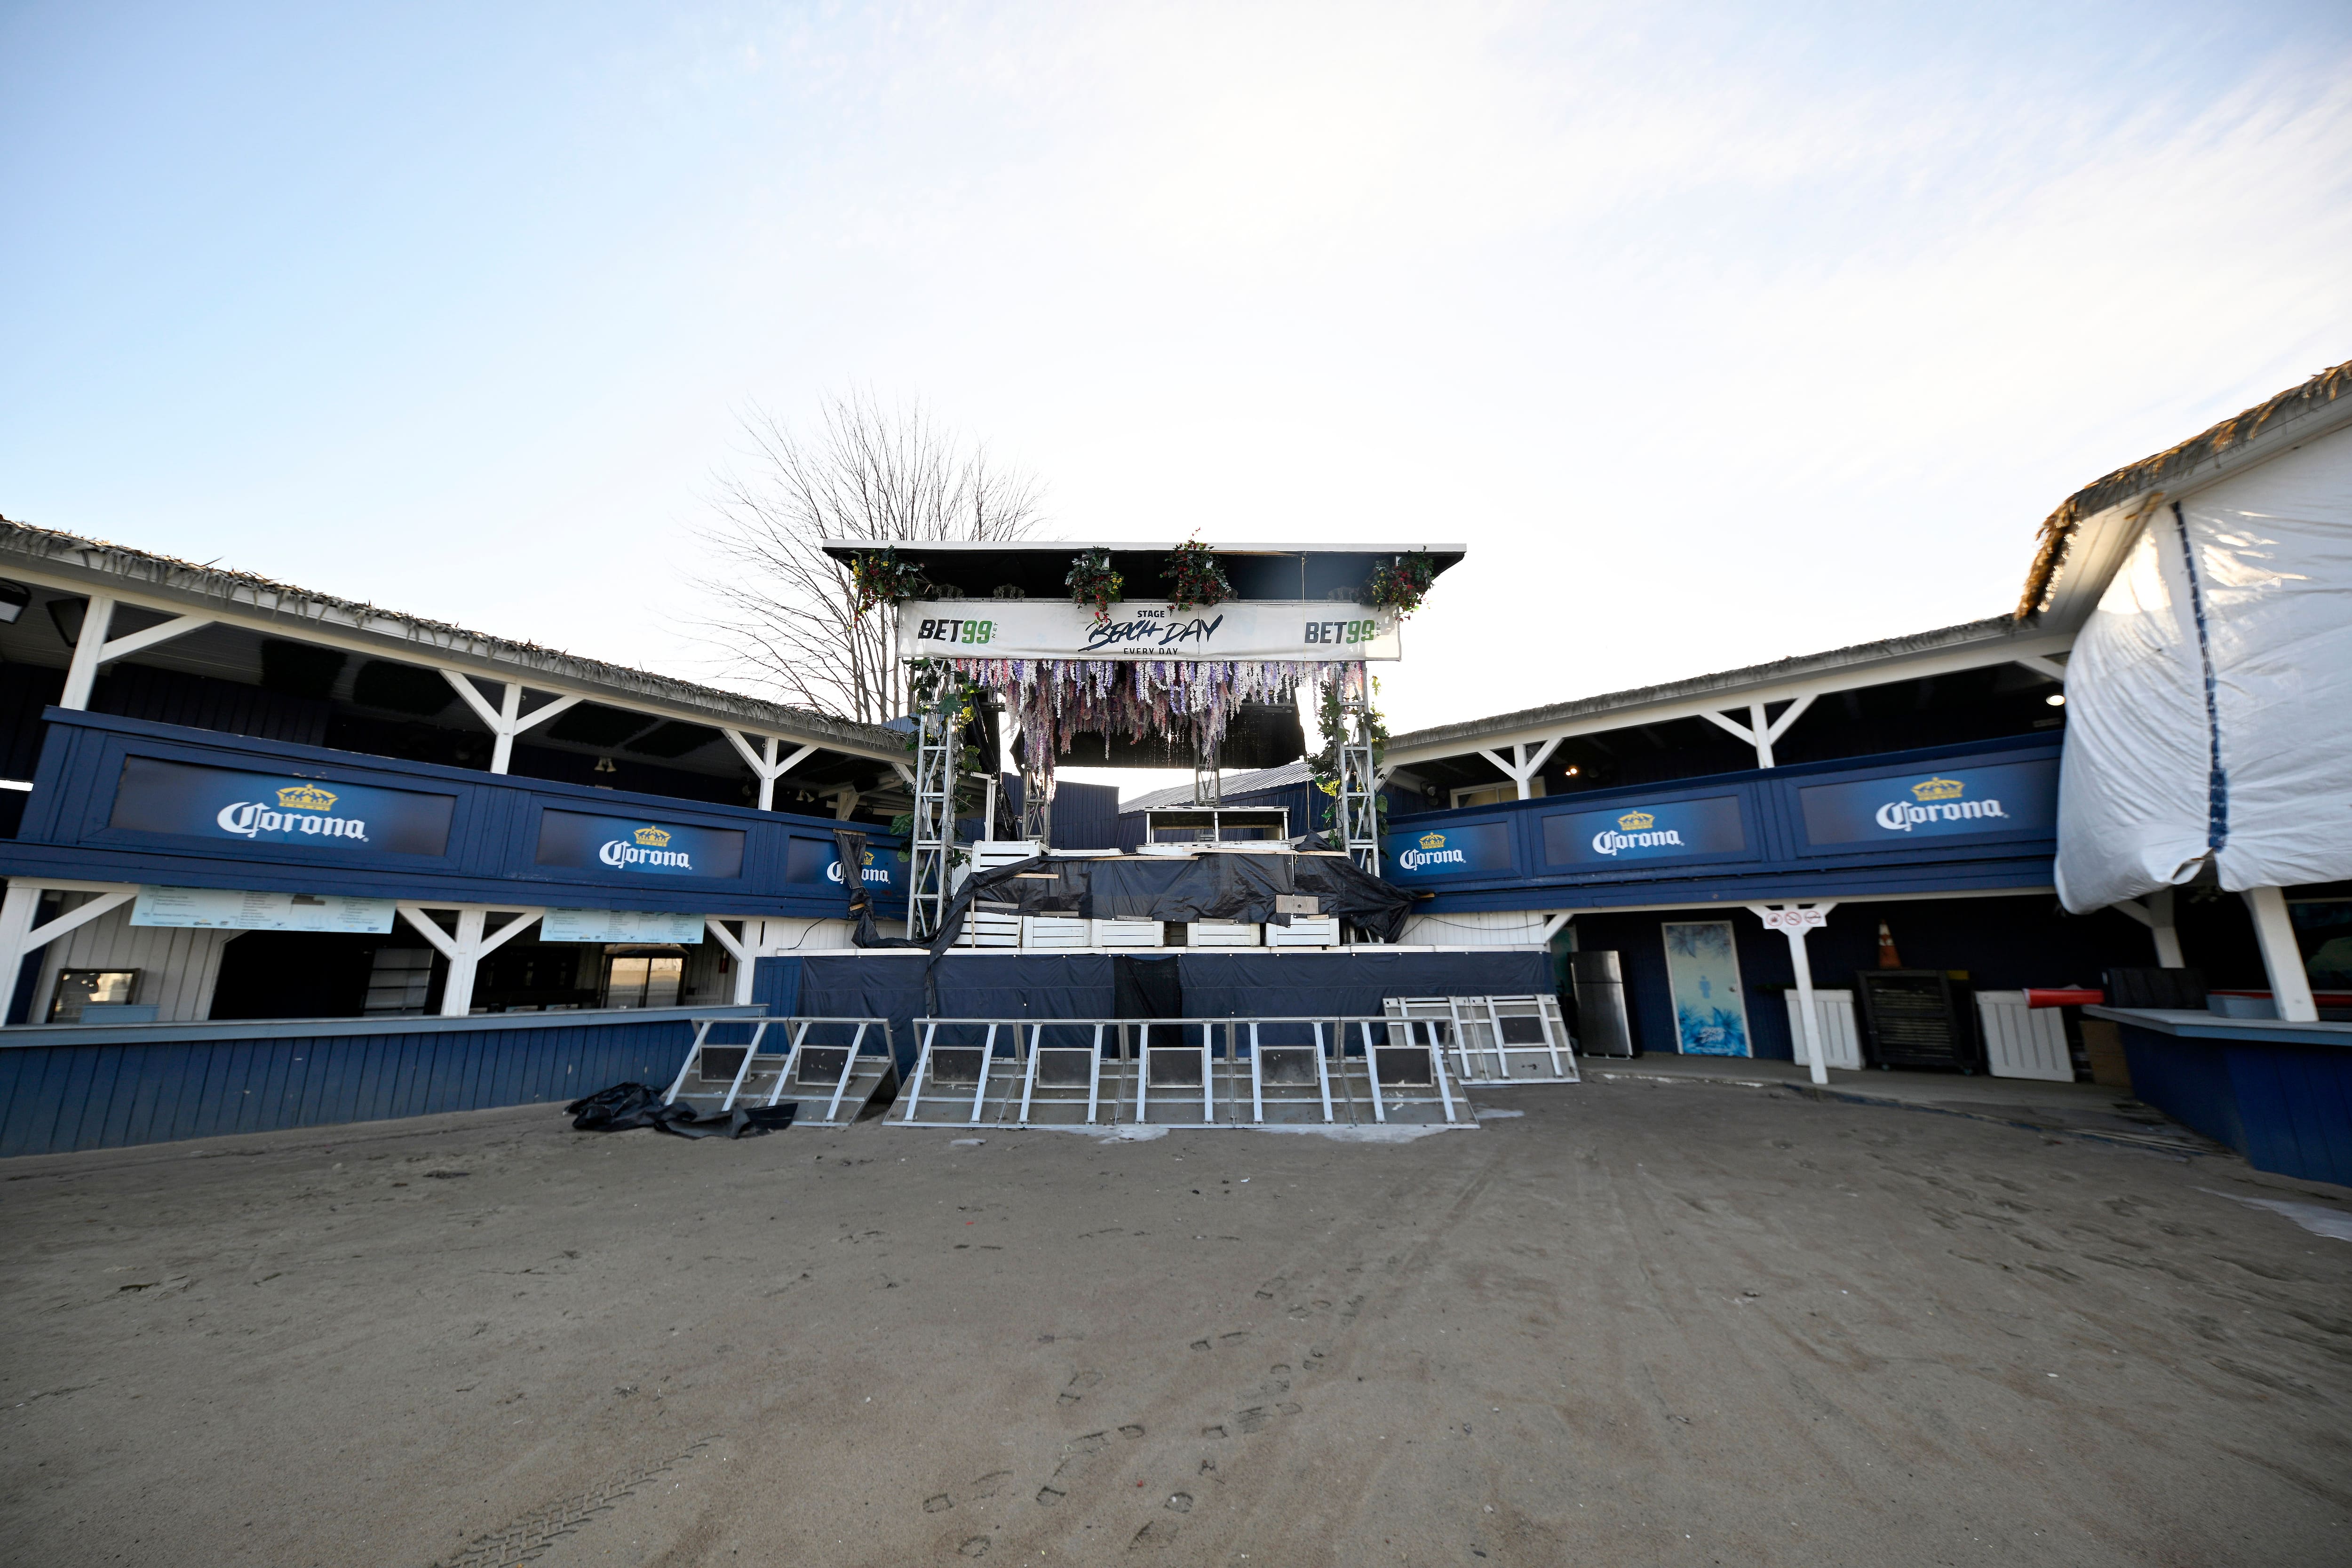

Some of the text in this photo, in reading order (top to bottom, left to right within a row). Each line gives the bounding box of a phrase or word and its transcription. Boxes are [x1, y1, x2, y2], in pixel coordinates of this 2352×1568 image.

[918, 620, 992, 644] BET99
[1078, 614, 1223, 652] BEACH DAY
[1304, 620, 1375, 644] BET99
[217, 802, 366, 839] Corona
[1876, 800, 2004, 831] Corona
[599, 841, 690, 869] Corona
[1592, 830, 1681, 856] Corona
[826, 861, 889, 884] Cona
[1400, 849, 1464, 870] Corona
